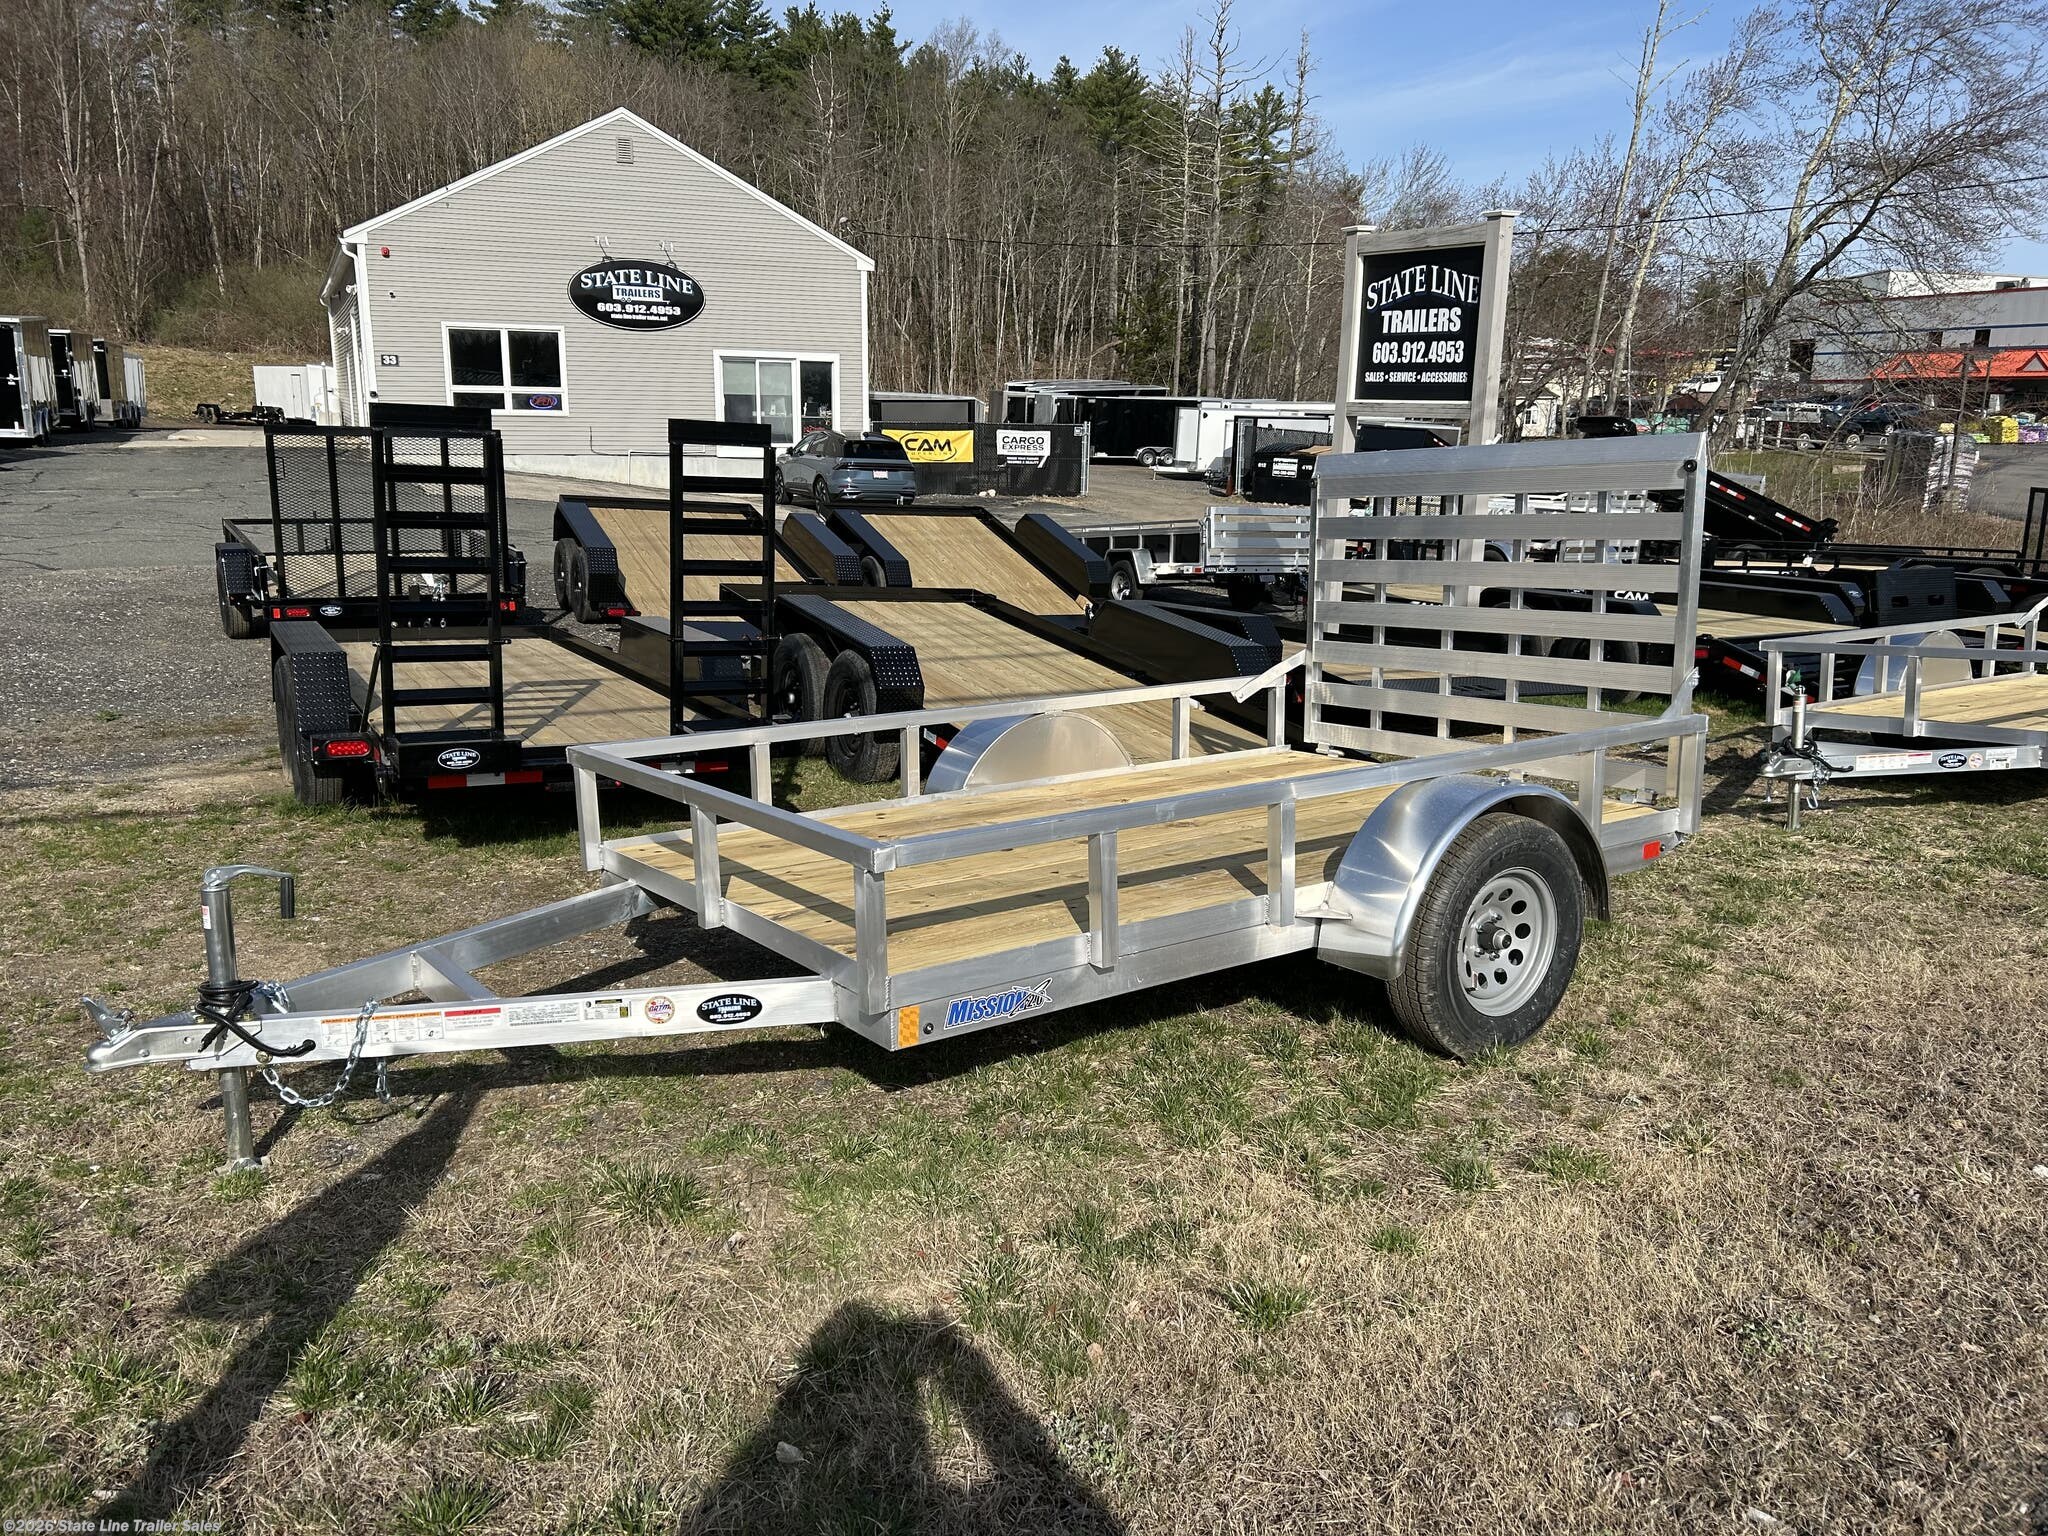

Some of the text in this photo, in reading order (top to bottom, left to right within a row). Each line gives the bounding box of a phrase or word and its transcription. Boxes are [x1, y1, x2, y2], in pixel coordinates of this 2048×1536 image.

[580, 269, 693, 294] STATE LINE
[1366, 265, 1480, 310] STATE LINE
[615, 287, 661, 298] TRAILERS
[597, 303, 681, 315] 603.912.4953
[1381, 307, 1462, 334] TRAILERS
[1372, 340, 1465, 364] 603.912.4953
[382, 355, 397, 365] 33
[1364, 371, 1469, 383] SALES SERVICE ACCESSORIES
[904, 438, 952, 451] CAM
[1002, 435, 1045, 445] CARGO
[1614, 590, 1649, 601] CAM
[701, 997, 757, 1011] STATE LINE
[946, 989, 1029, 1028] MISSION
